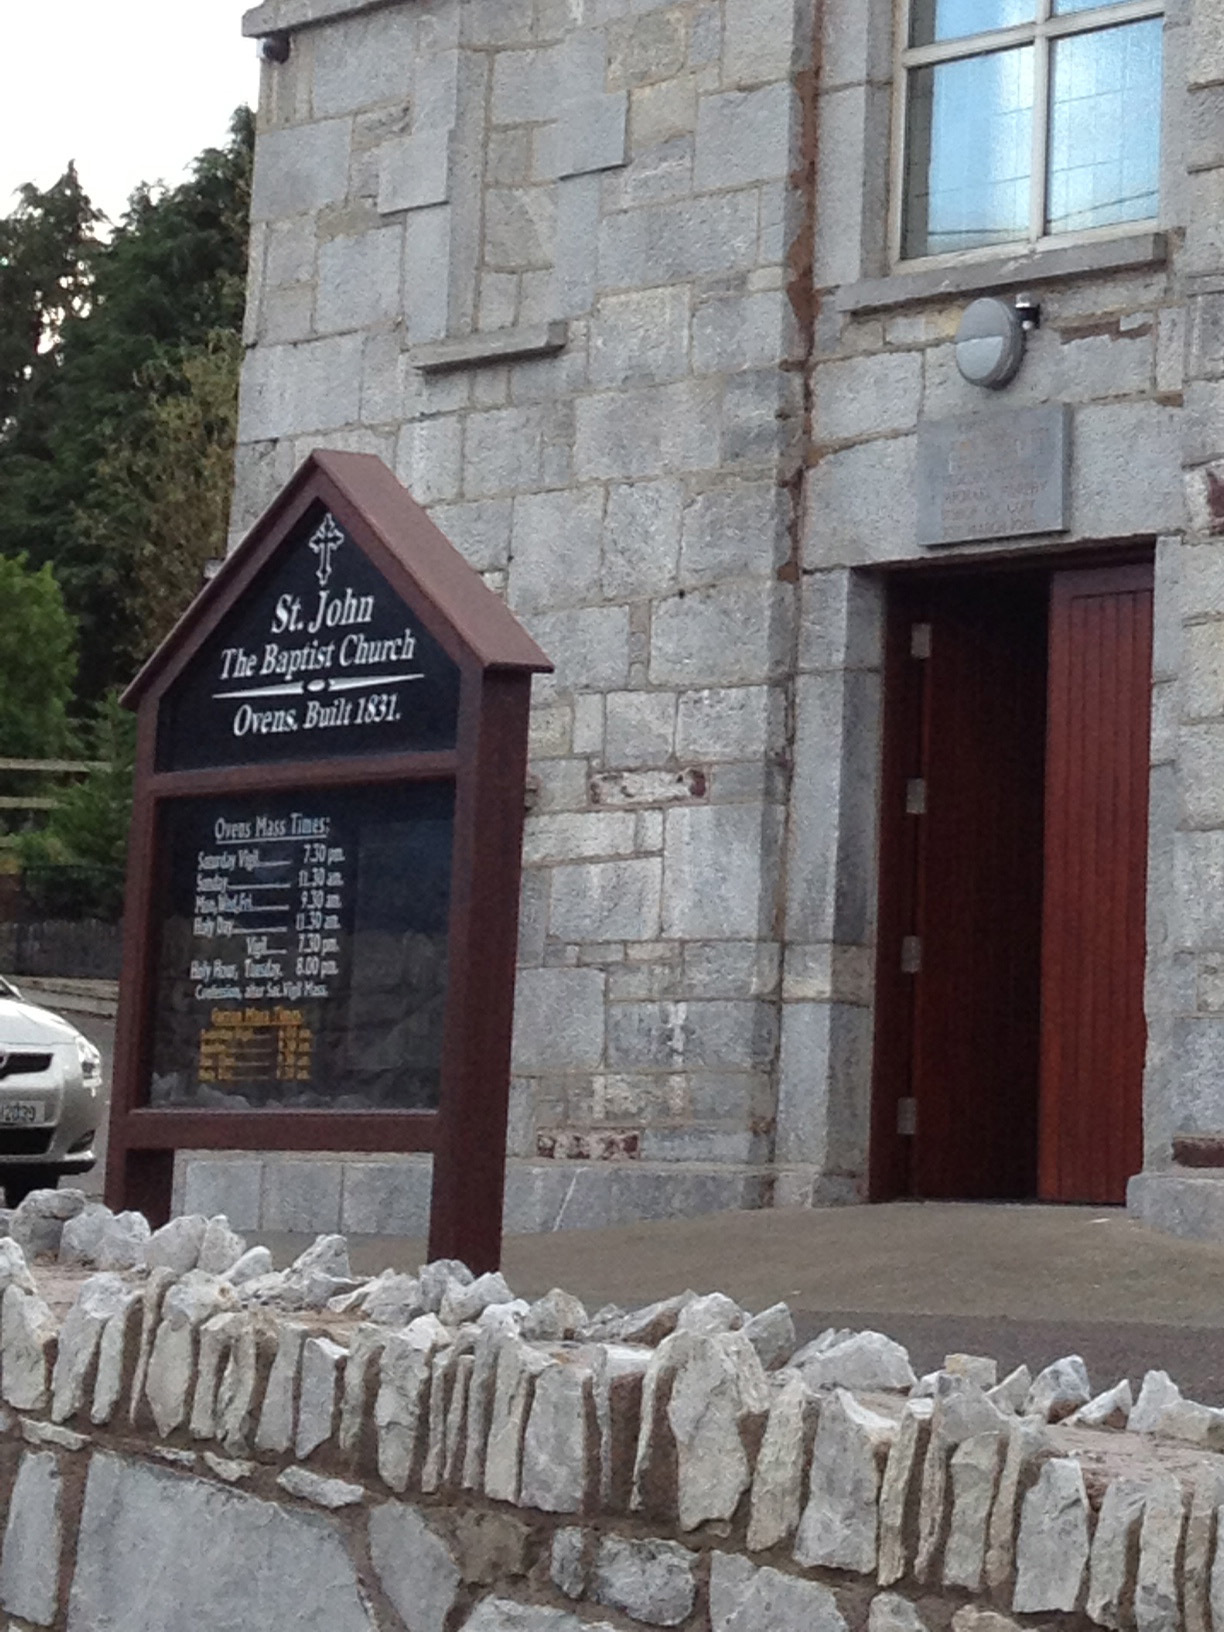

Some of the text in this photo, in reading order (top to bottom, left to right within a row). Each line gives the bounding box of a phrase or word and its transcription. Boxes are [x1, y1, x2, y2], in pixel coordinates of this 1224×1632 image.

[271, 588, 374, 633] St. John
[220, 628, 416, 681] The Baptist Church
[233, 693, 401, 736] Ovens. Built 1831.
[215, 817, 251, 840] Ovens
[255, 816, 286, 838] Mass
[197, 851, 236, 871] Saturday
[303, 843, 326, 864] 7.30
[196, 873, 229, 893] Sunday
